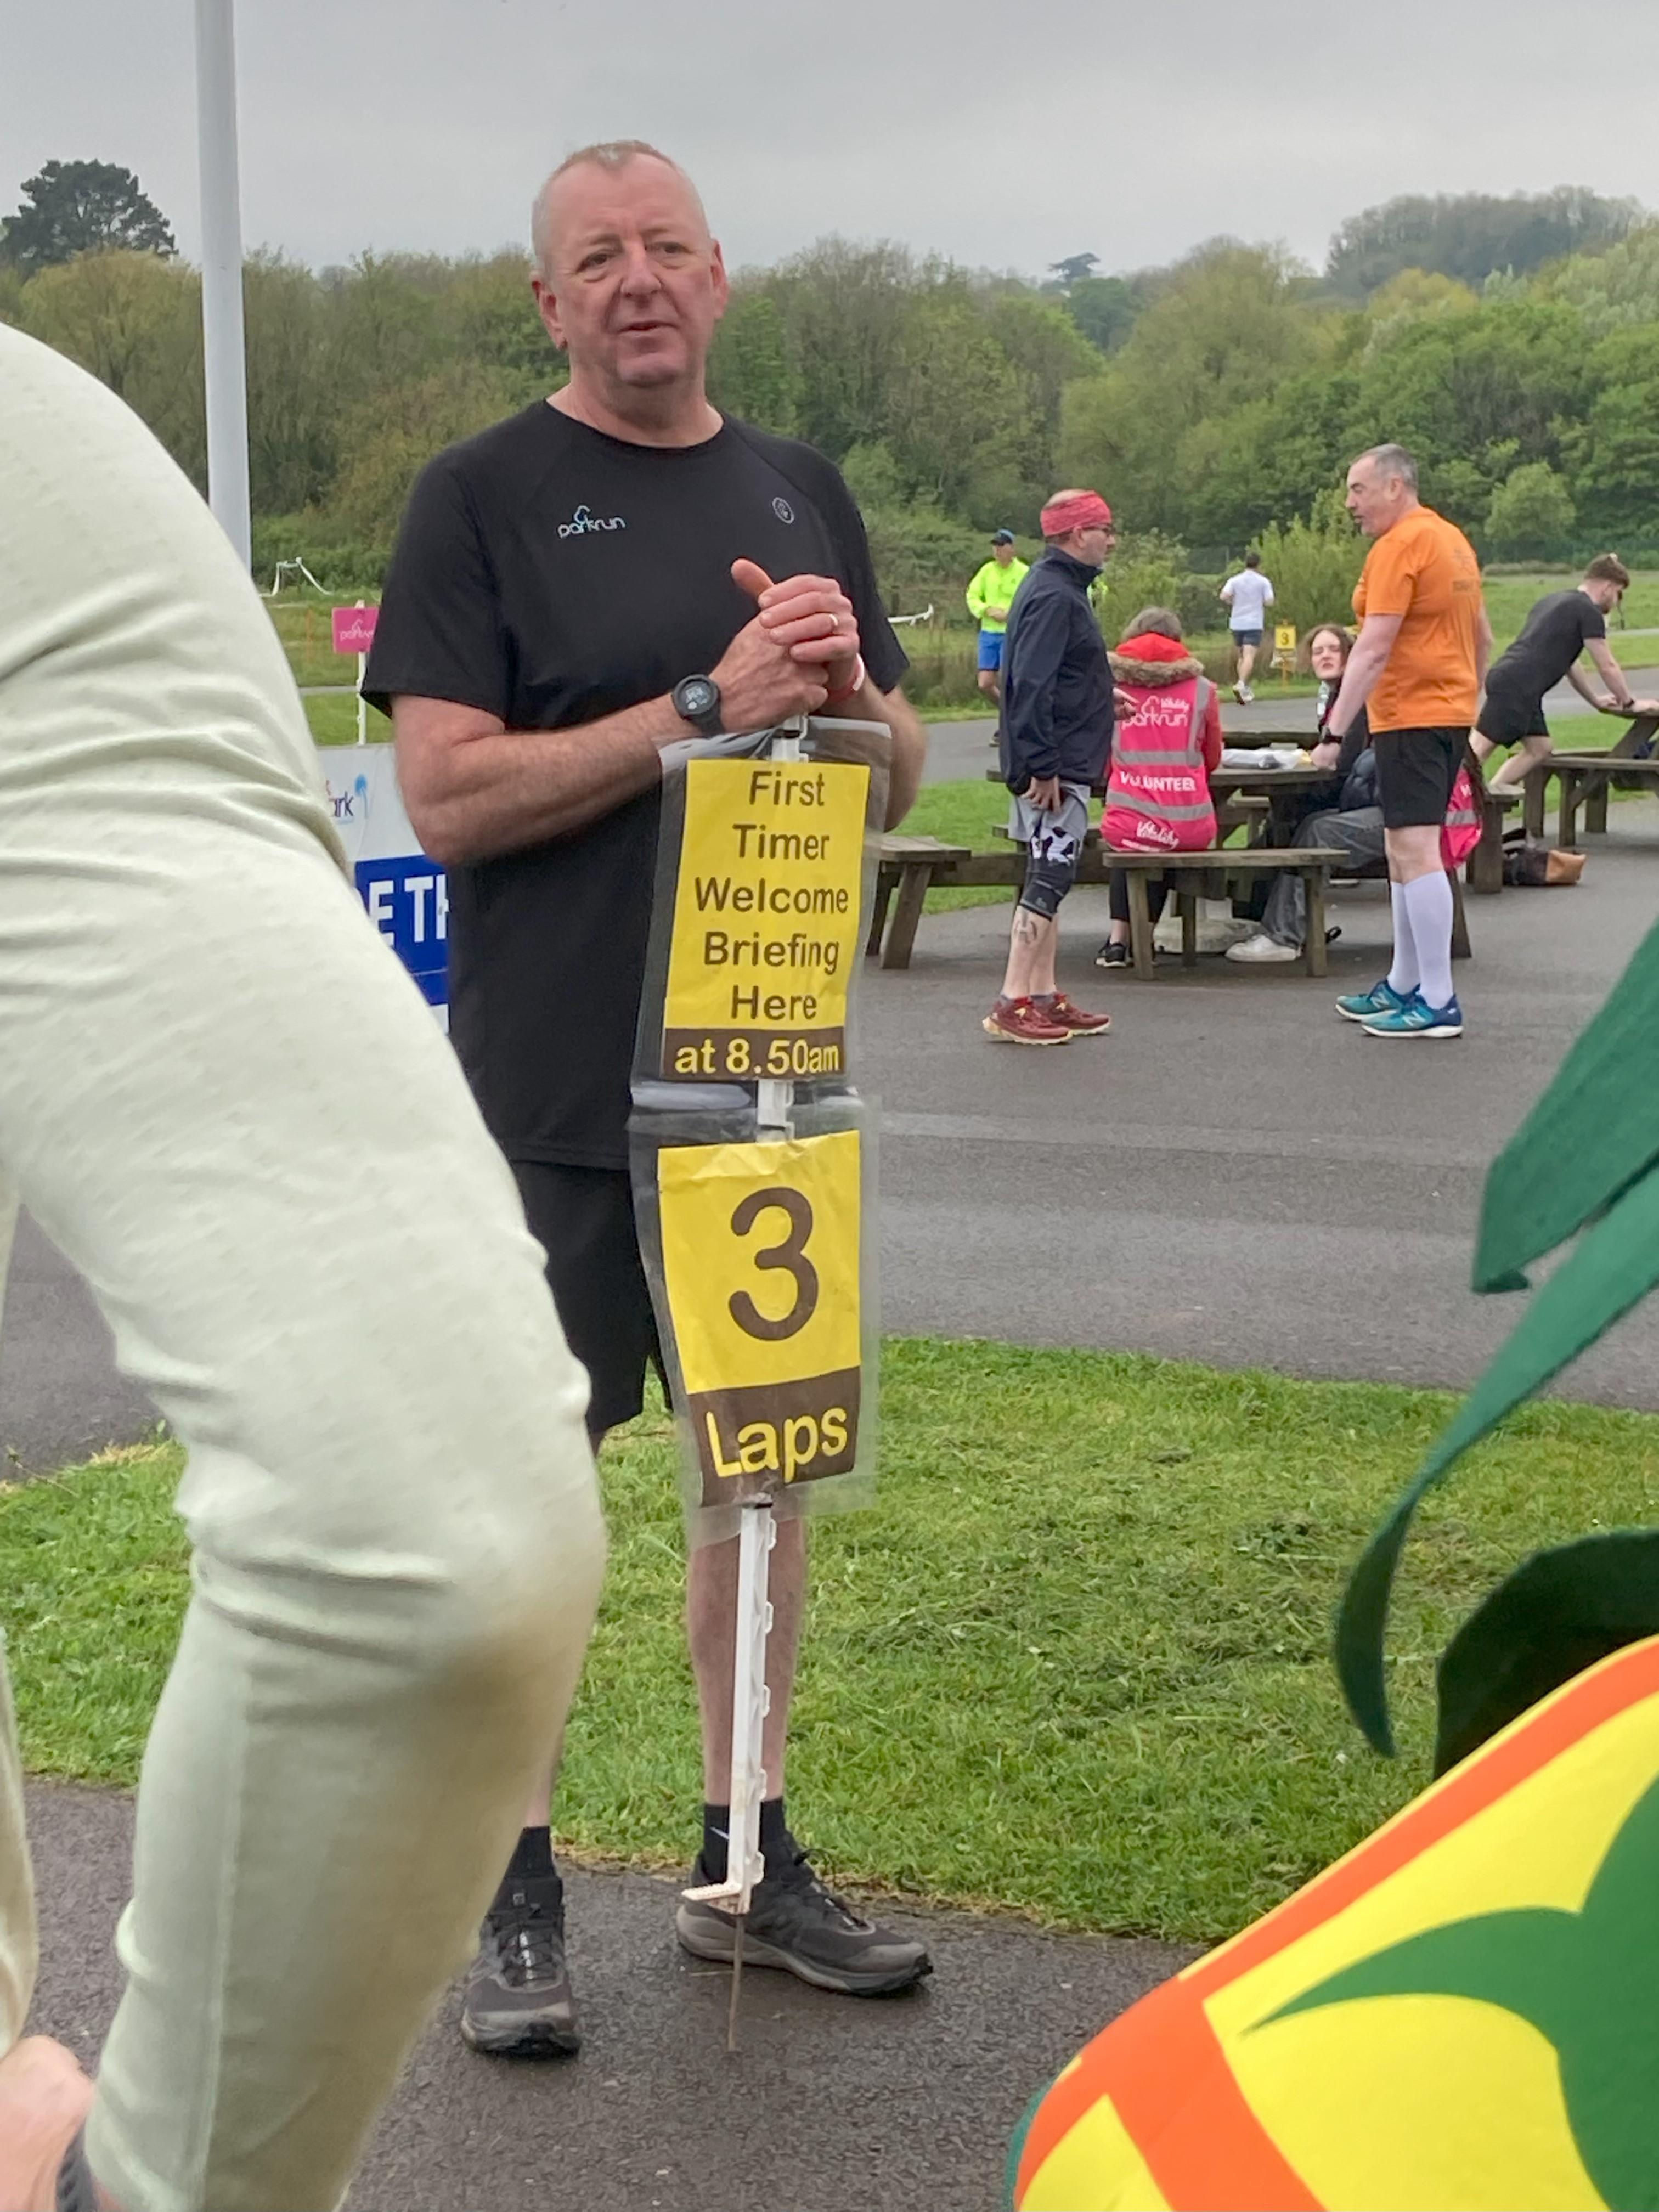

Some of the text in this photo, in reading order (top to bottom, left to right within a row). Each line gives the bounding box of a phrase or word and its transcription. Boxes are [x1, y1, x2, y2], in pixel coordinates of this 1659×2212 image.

[558, 505, 625, 539] parkrun
[1280, 631, 1289, 645] 3
[1121, 701, 1188, 730] parkrun
[749, 771, 825, 806] First
[1120, 771, 1196, 791] VOUNTEER
[732, 823, 831, 860] Timer
[695, 877, 848, 914] Welcome
[704, 931, 839, 975] Briefing
[730, 984, 817, 1020] Here
[674, 1037, 839, 1075] at 8.50am
[727, 1186, 819, 1342] 3
[706, 1407, 848, 1483] Laps
